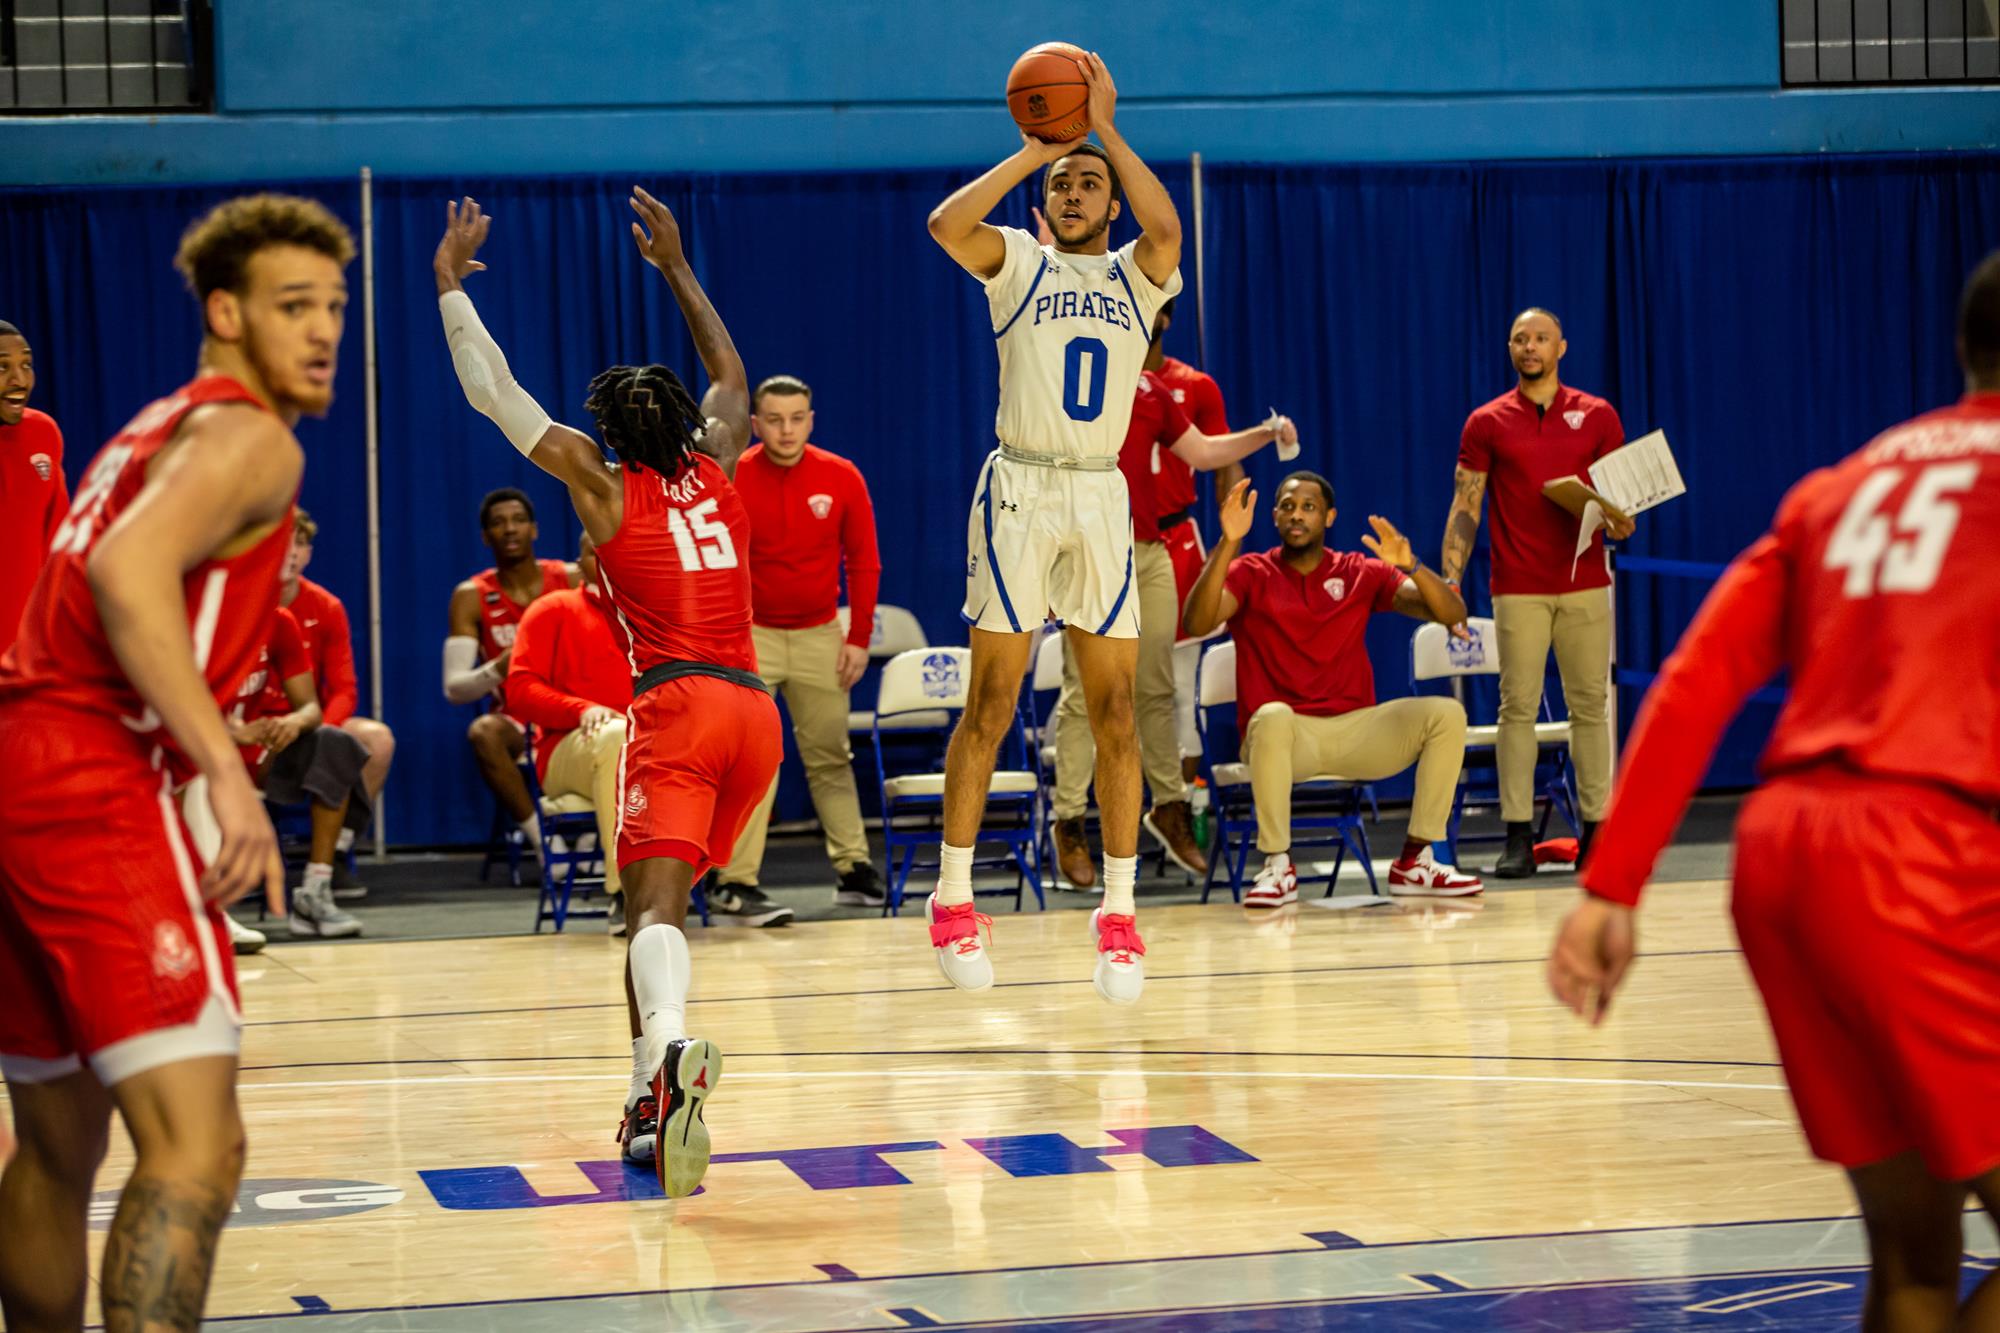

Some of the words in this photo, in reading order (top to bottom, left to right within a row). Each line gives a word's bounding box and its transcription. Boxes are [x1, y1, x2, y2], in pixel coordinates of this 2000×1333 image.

[1034, 291, 1131, 331] PIRATES
[1063, 336, 1108, 422] 0
[667, 497, 738, 572] 15
[1823, 460, 1980, 599] 45
